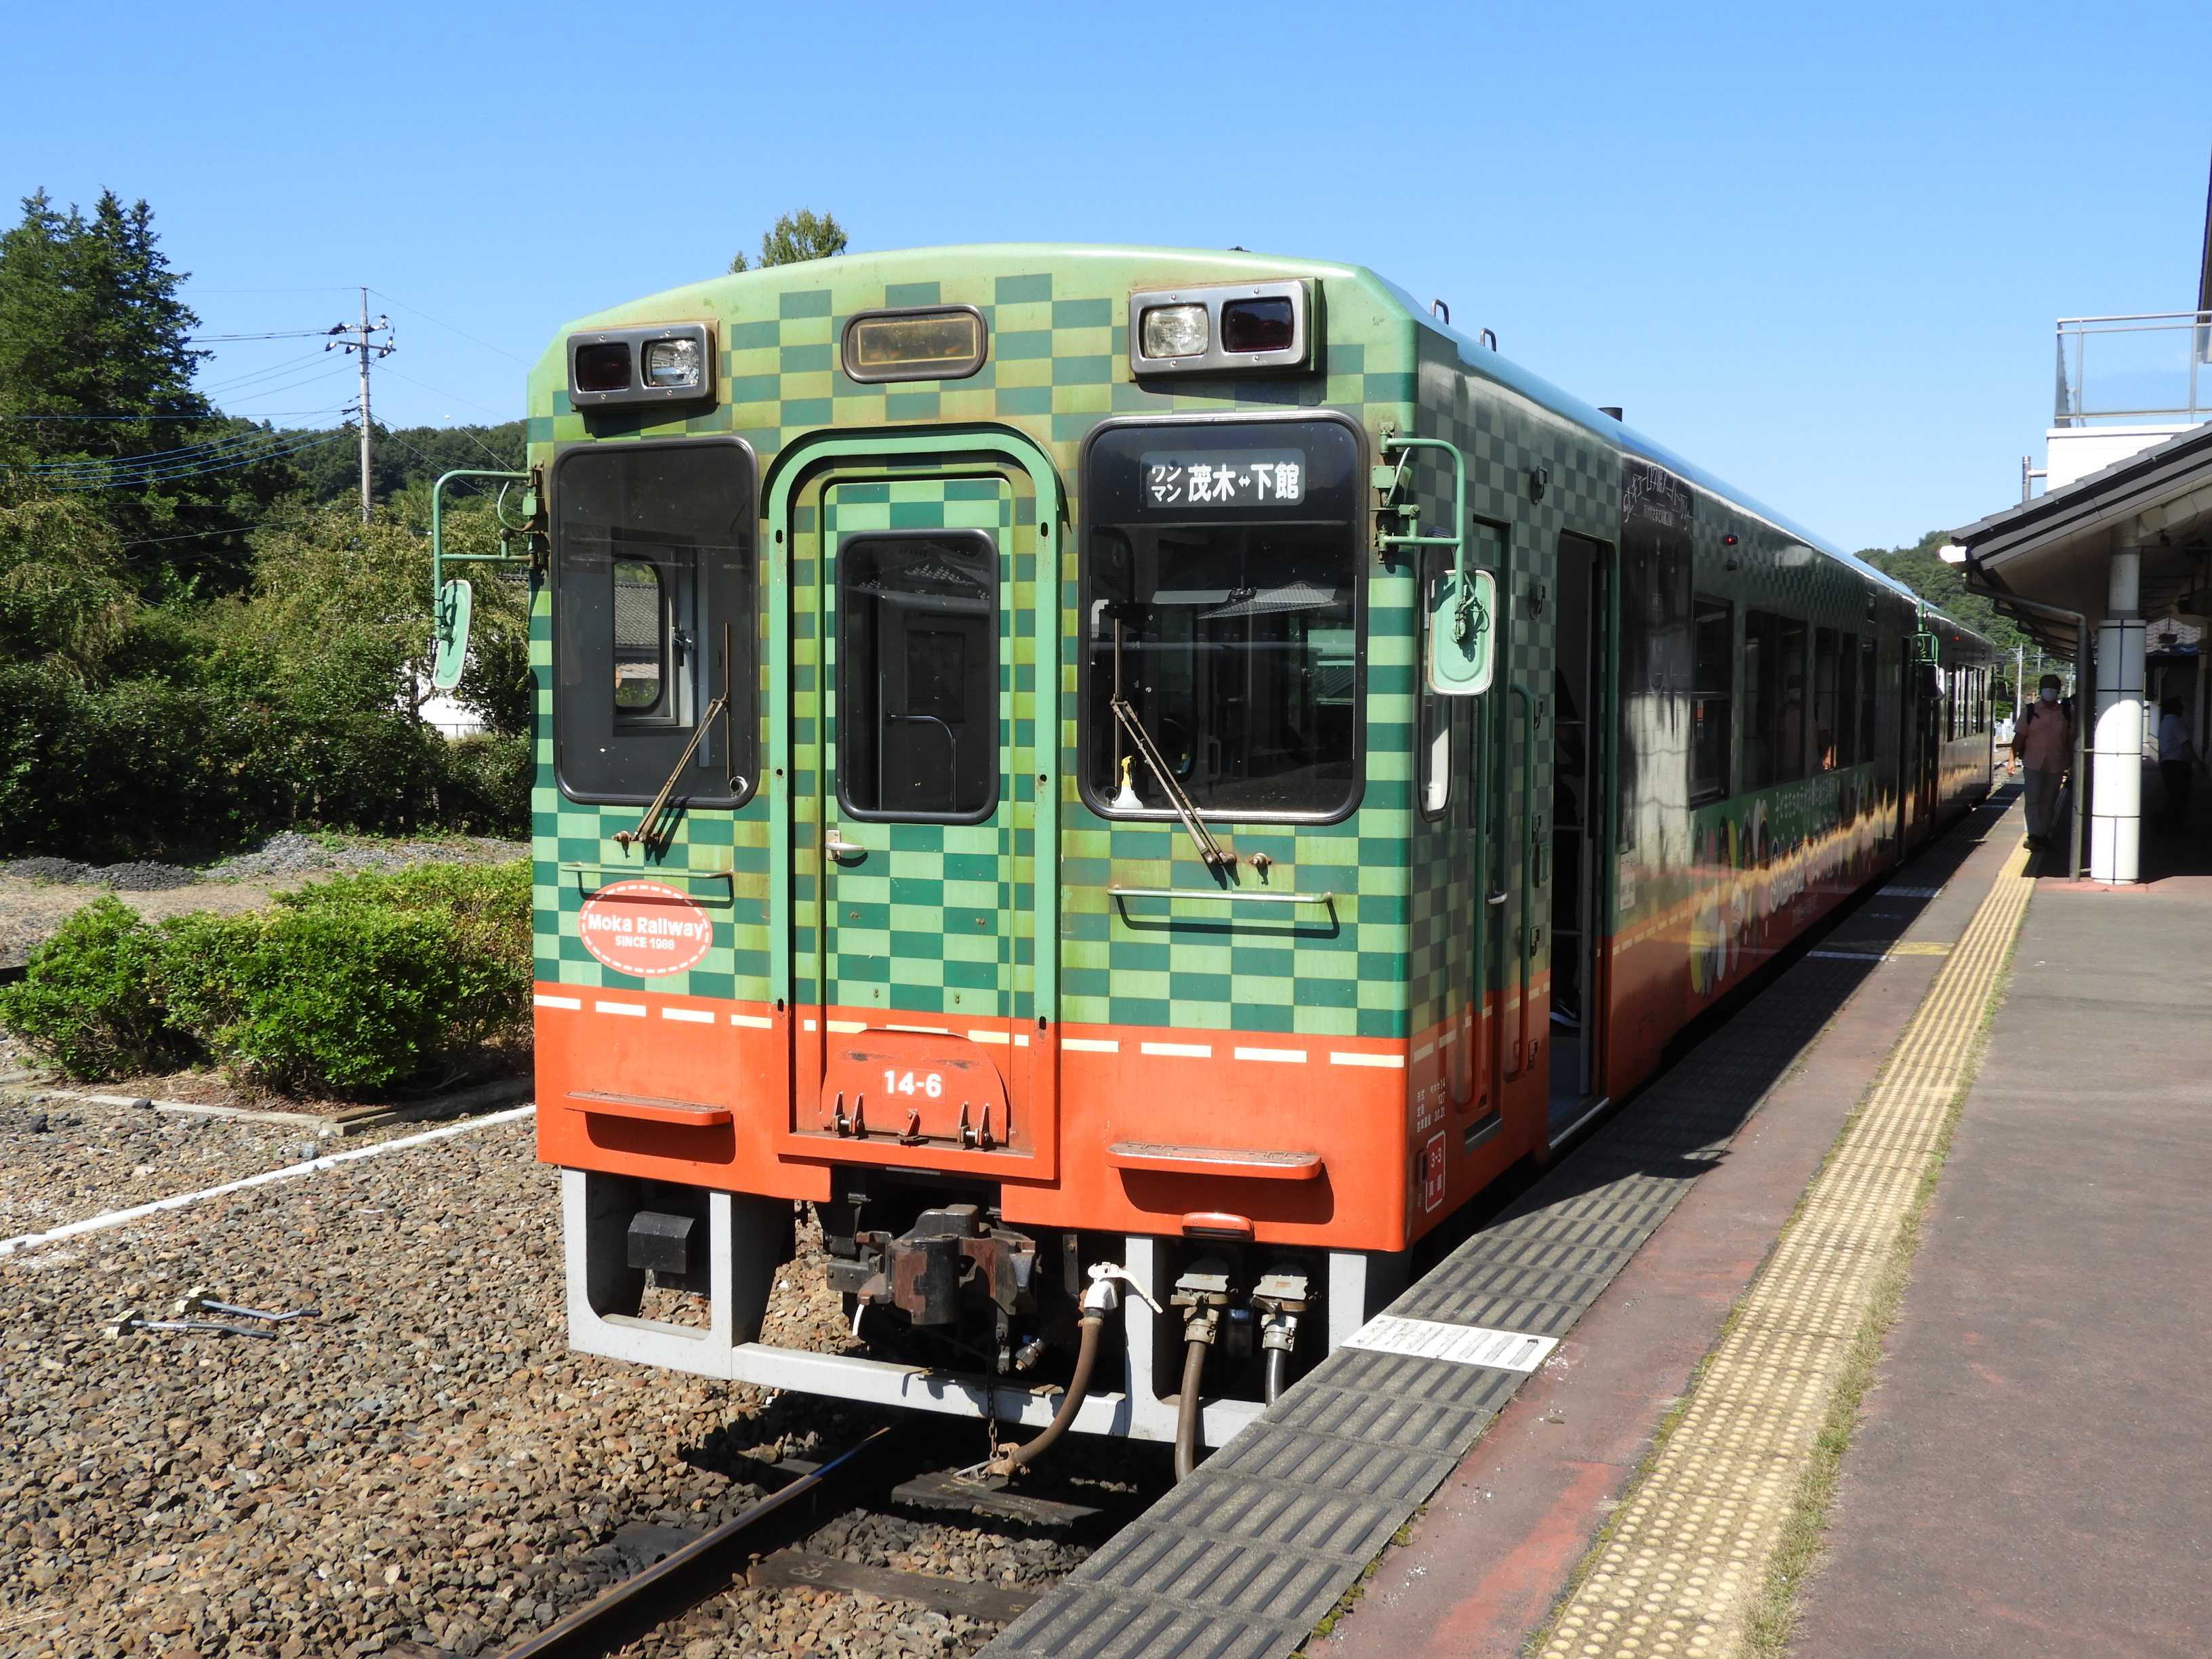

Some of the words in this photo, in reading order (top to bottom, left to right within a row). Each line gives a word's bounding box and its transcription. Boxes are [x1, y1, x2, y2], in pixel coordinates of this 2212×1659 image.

[1151, 463, 1181, 483] ワン
[1187, 462, 1236, 501] 茂木
[1250, 461, 1299, 500] 下館
[1151, 484, 1181, 502] マン
[588, 913, 632, 933] Moka
[637, 916, 704, 941] Railway
[615, 935, 647, 948] SINCE
[649, 938, 675, 950] 1988
[884, 1069, 942, 1098] 14-6
